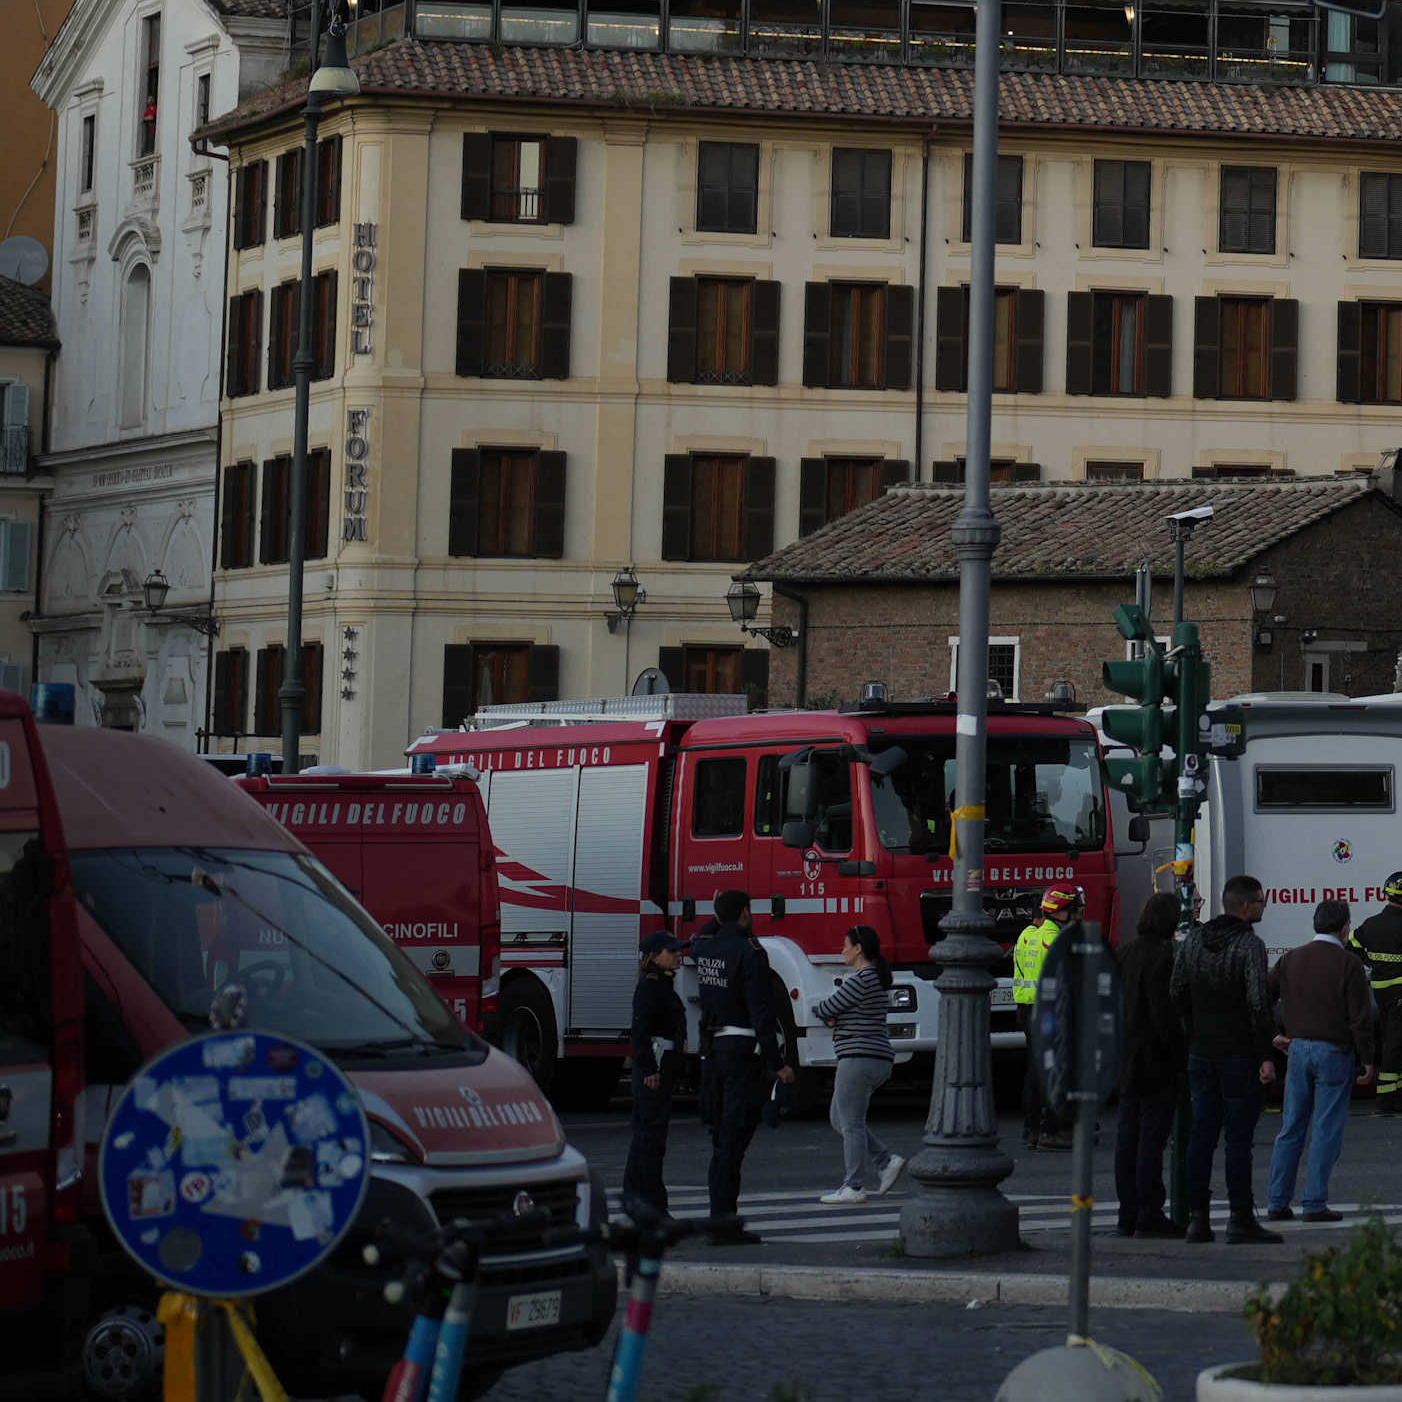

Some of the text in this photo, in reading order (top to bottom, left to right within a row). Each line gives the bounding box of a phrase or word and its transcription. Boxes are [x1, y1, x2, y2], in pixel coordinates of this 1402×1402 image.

[352, 223, 377, 355] HOTEL
[344, 408, 368, 541] FORUM
[449, 747, 612, 771] VIGILI DEL FUOCO
[346, 802, 385, 825] DEL
[391, 802, 467, 825] FUOCO
[688, 862, 744, 874] www.vigilfuoco.it
[990, 867, 1024, 881] DEL
[1025, 866, 1075, 881] FUOCO
[799, 882, 825, 896] 115
[1323, 887, 1359, 903] DEL
[383, 922, 459, 939] CINOFILI
[697, 957, 725, 969] POLIZIA
[698, 966, 720, 978] ROMA
[697, 974, 729, 988] CAPITALE
